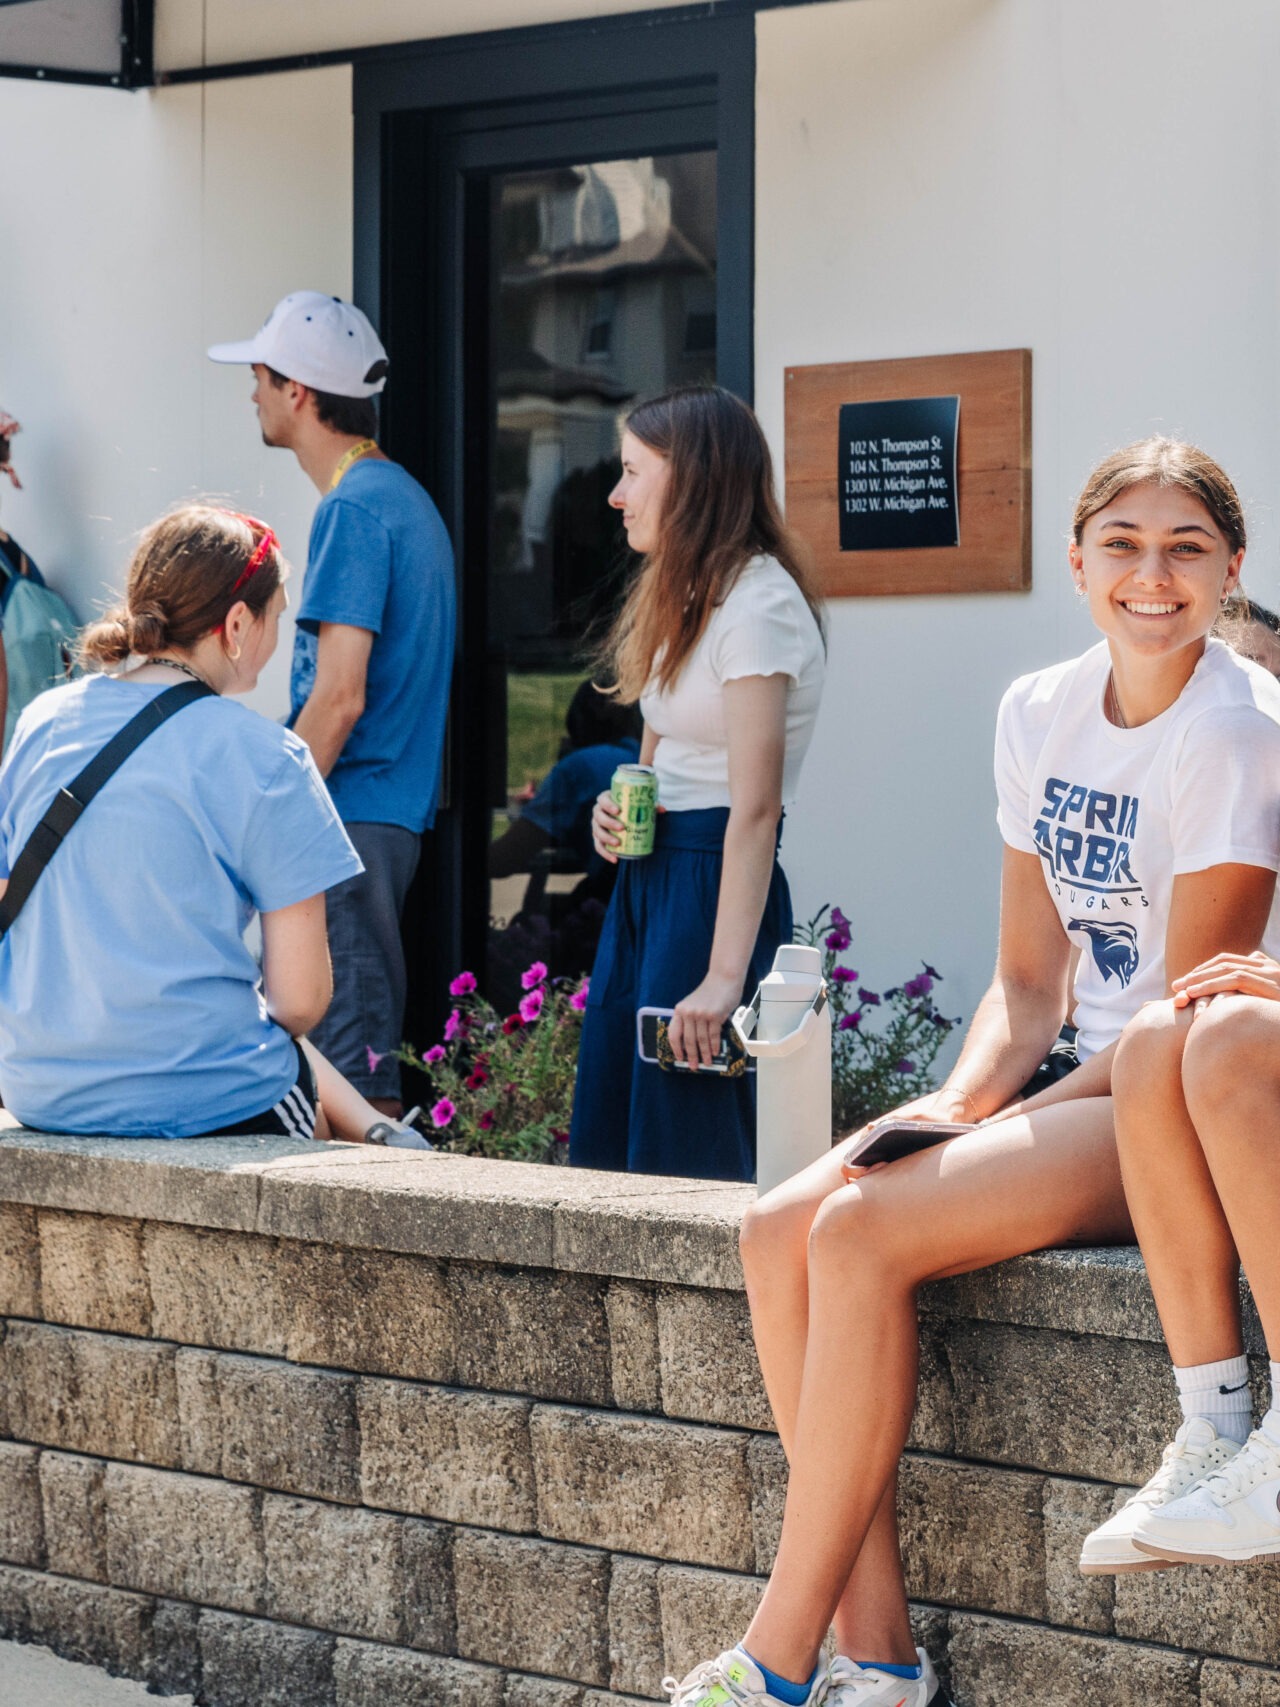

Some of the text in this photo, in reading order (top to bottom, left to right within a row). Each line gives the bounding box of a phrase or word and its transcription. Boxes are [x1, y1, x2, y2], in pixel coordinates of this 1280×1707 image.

[849, 435, 943, 455] 102 N. Thompson St.
[849, 455, 943, 474] 104 N. Thompson St.
[845, 475, 948, 494] 1300 W. Michigan Ave.
[845, 494, 949, 514] 1302 W. Michigan Ave.
[1055, 884, 1149, 910] OUGARS
